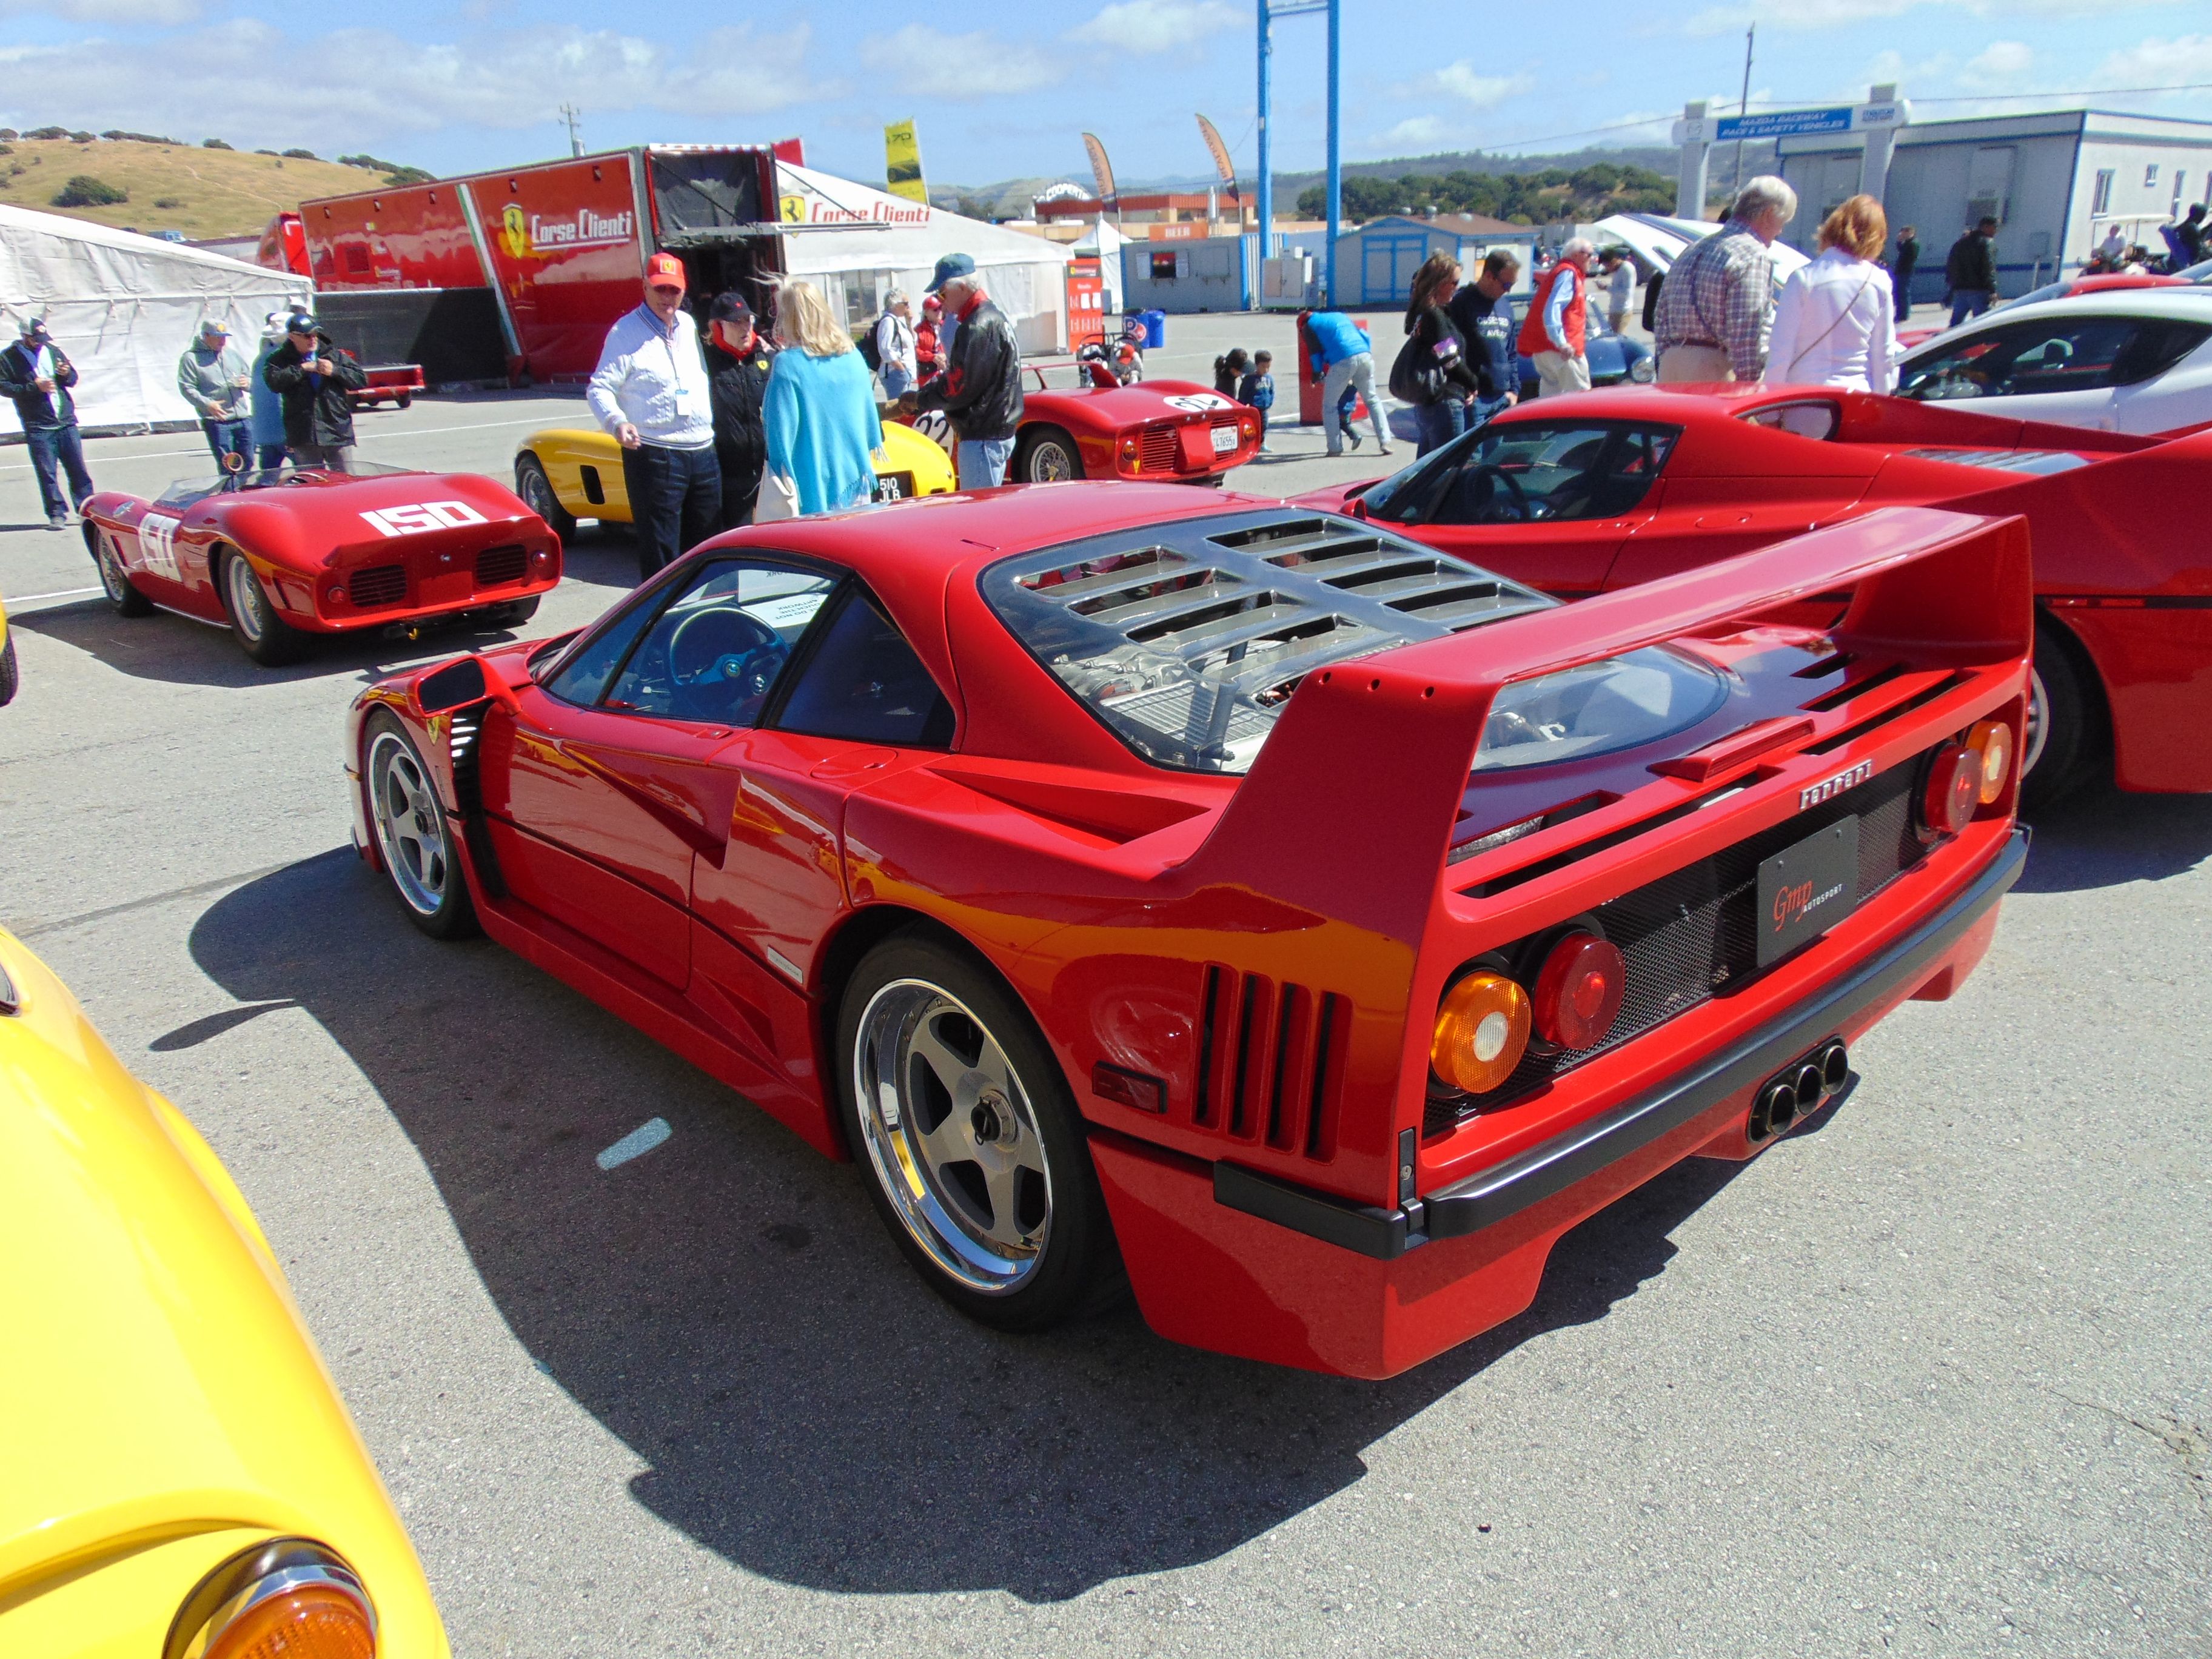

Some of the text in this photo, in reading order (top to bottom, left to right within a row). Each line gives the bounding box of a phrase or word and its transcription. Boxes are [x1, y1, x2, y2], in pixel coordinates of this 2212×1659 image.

[873, 201, 931, 222] Clienti
[531, 209, 632, 243] Corse Clienti
[1165, 226, 1190, 238] BEER
[879, 477, 897, 491] 510
[879, 489, 902, 503] JLB
[359, 500, 489, 537] 150
[777, 598, 818, 611] ARTWORK
[796, 602, 821, 611] OUCH
[1799, 758, 1872, 809] Ferrari
[1774, 880, 1843, 932] Gmp AUTOSPORT
